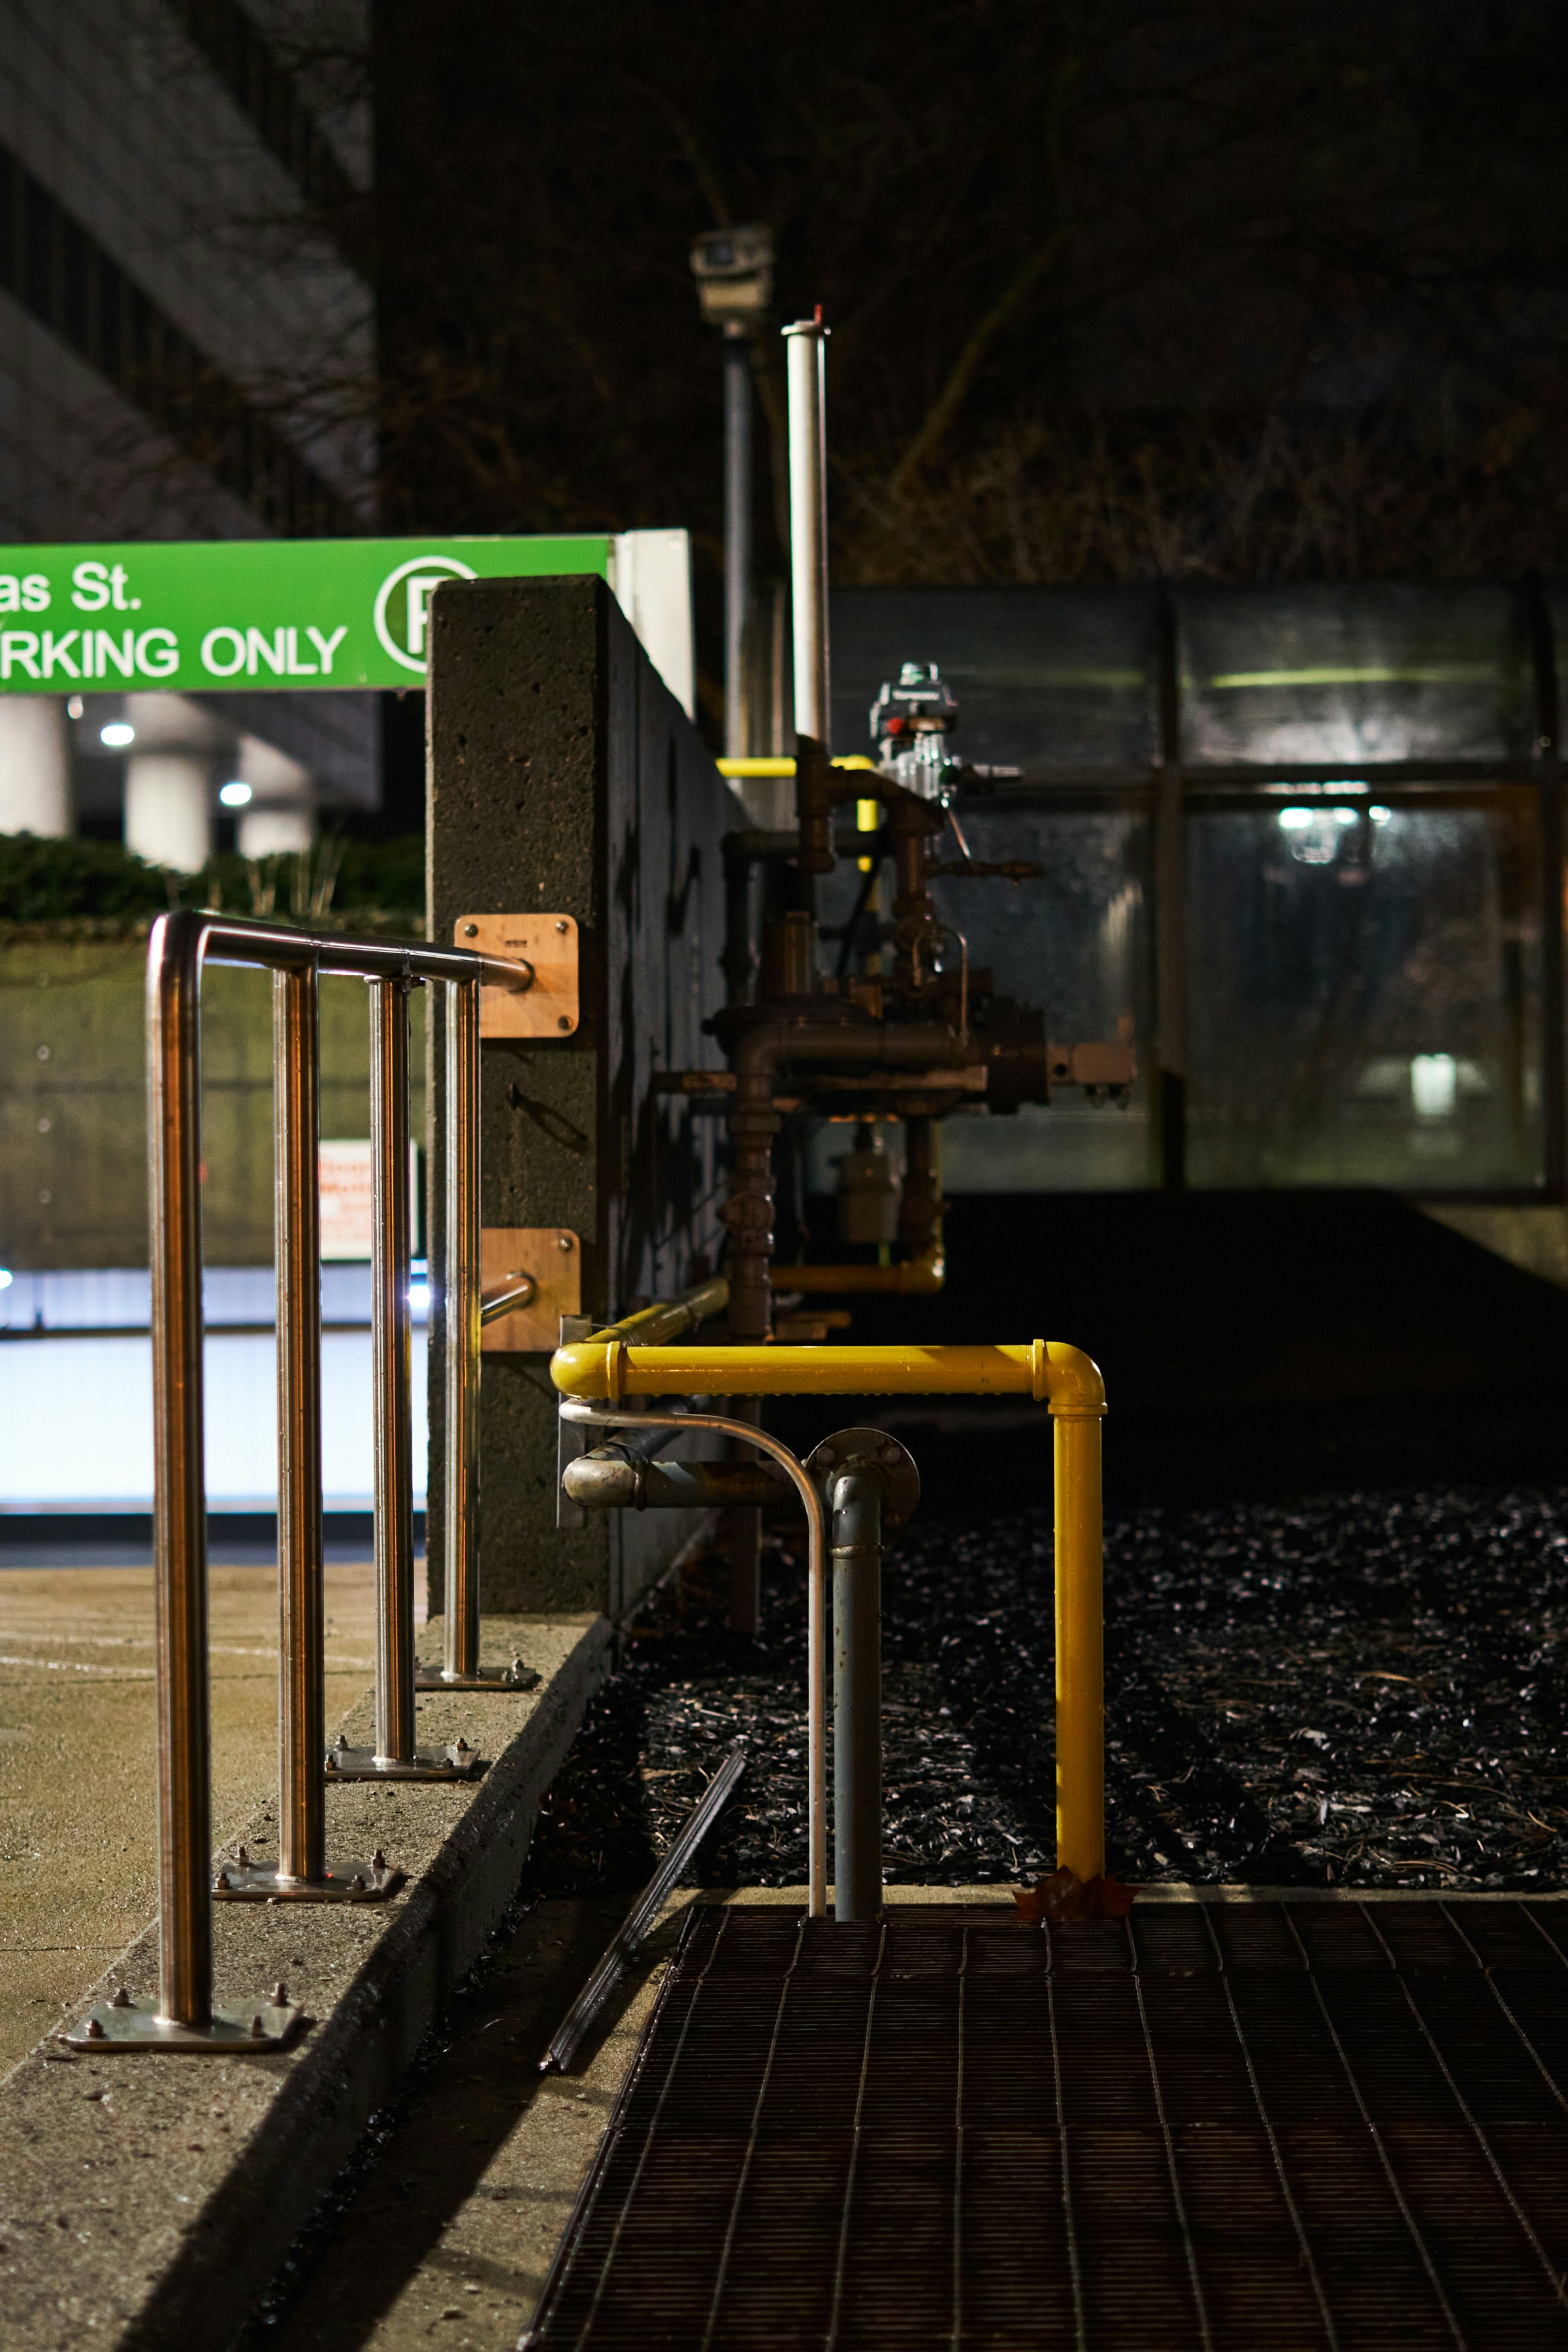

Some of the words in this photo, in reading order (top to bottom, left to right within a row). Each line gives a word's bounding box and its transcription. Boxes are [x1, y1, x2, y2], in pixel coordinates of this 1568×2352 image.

[71, 561, 142, 611] St.
[0, 627, 180, 679] RKING
[201, 625, 348, 677] ONLY
